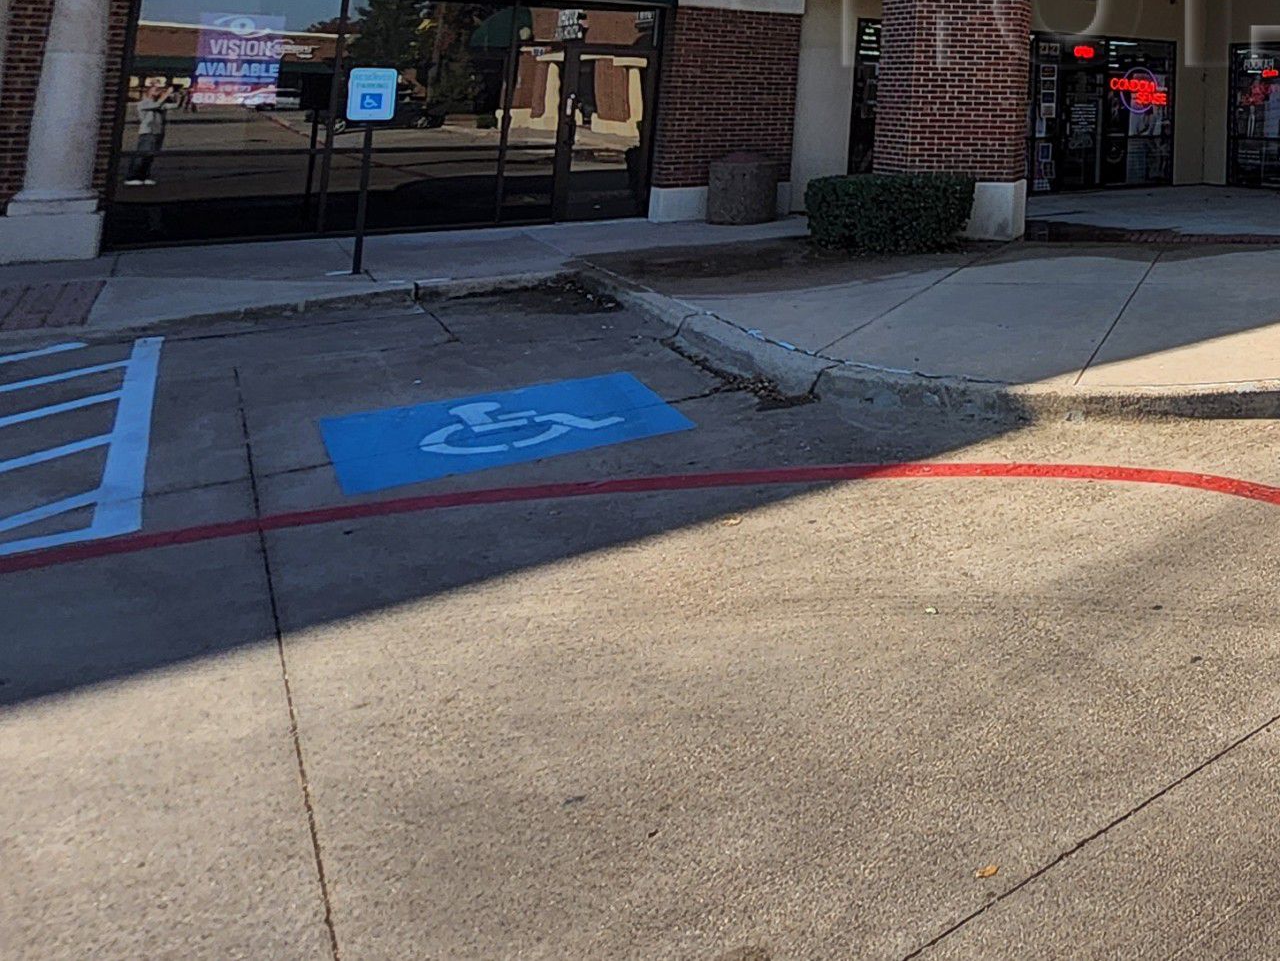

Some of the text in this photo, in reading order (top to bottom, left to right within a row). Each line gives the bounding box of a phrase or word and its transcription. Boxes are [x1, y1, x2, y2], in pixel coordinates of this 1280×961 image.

[195, 62, 280, 77] AVAILABLE
[1110, 78, 1155, 92] CONDOM
[1135, 92, 1168, 105] SENSE
